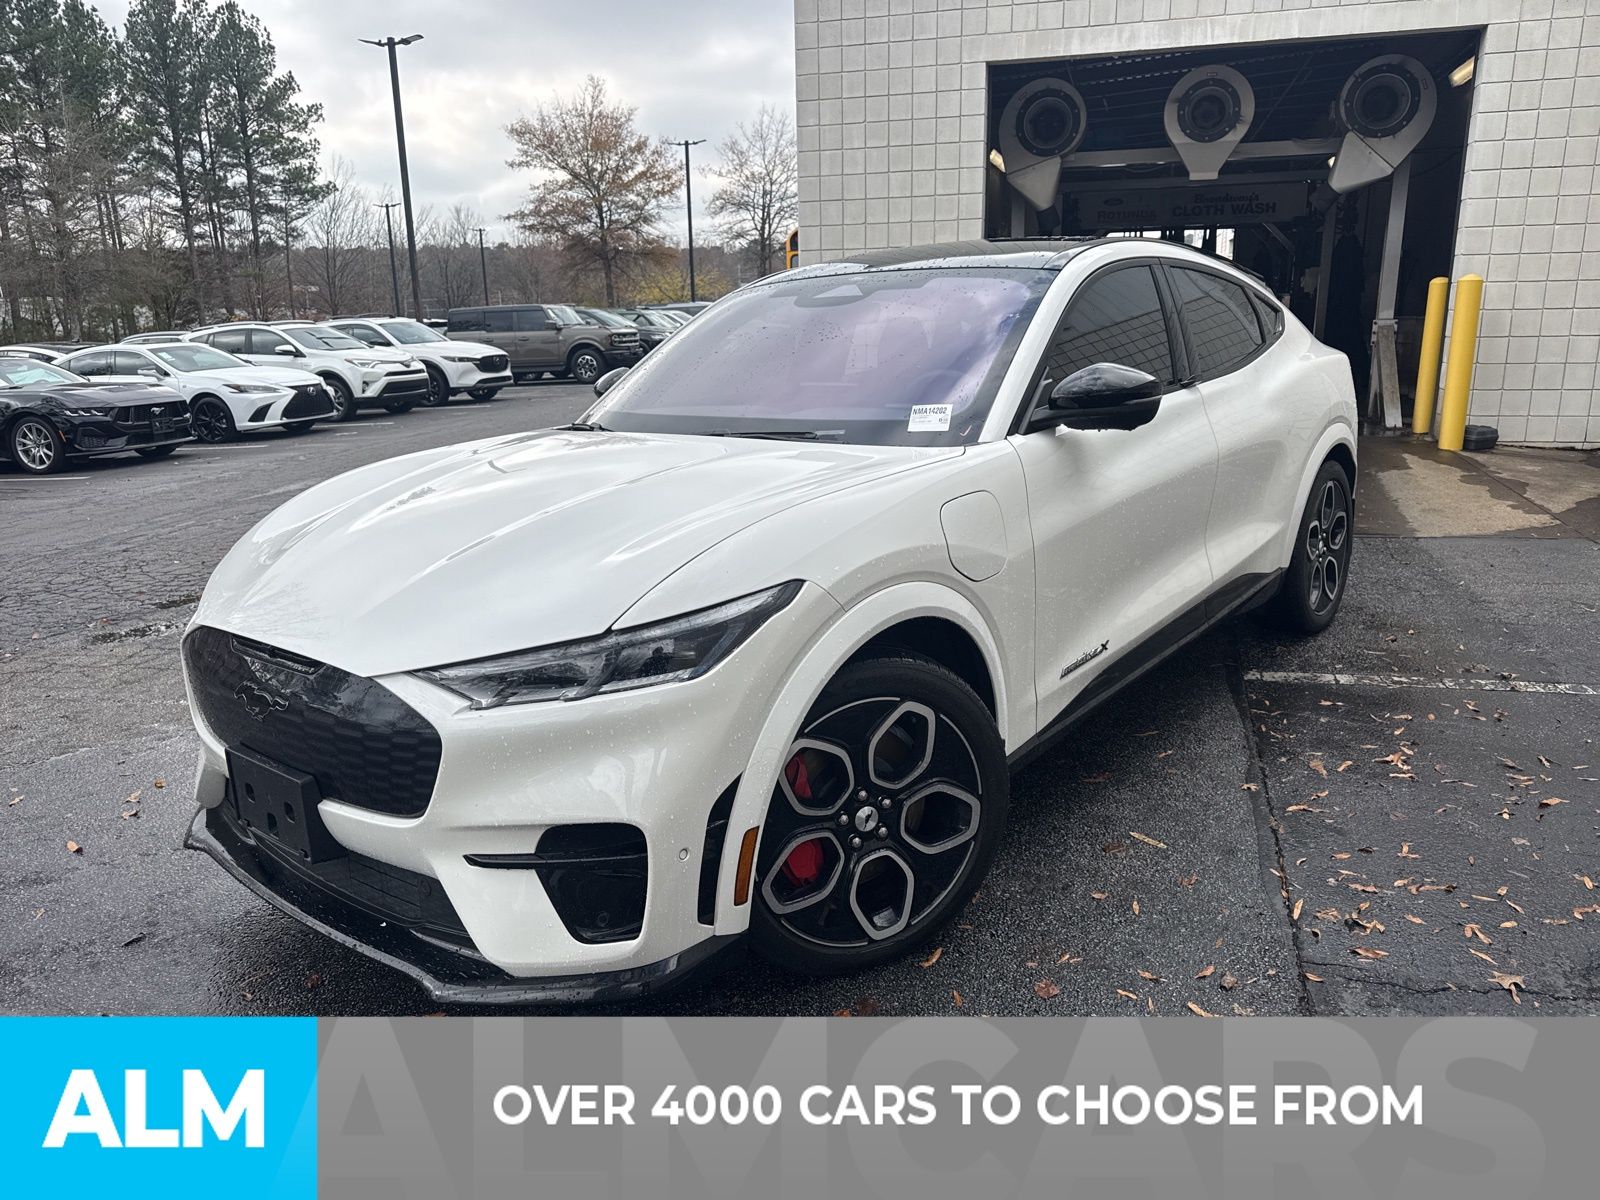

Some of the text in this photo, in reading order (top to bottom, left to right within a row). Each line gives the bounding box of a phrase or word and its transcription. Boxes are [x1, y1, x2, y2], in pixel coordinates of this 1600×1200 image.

[1172, 202, 1277, 217] CLOTH WASH
[912, 406, 948, 415] NMA14202
